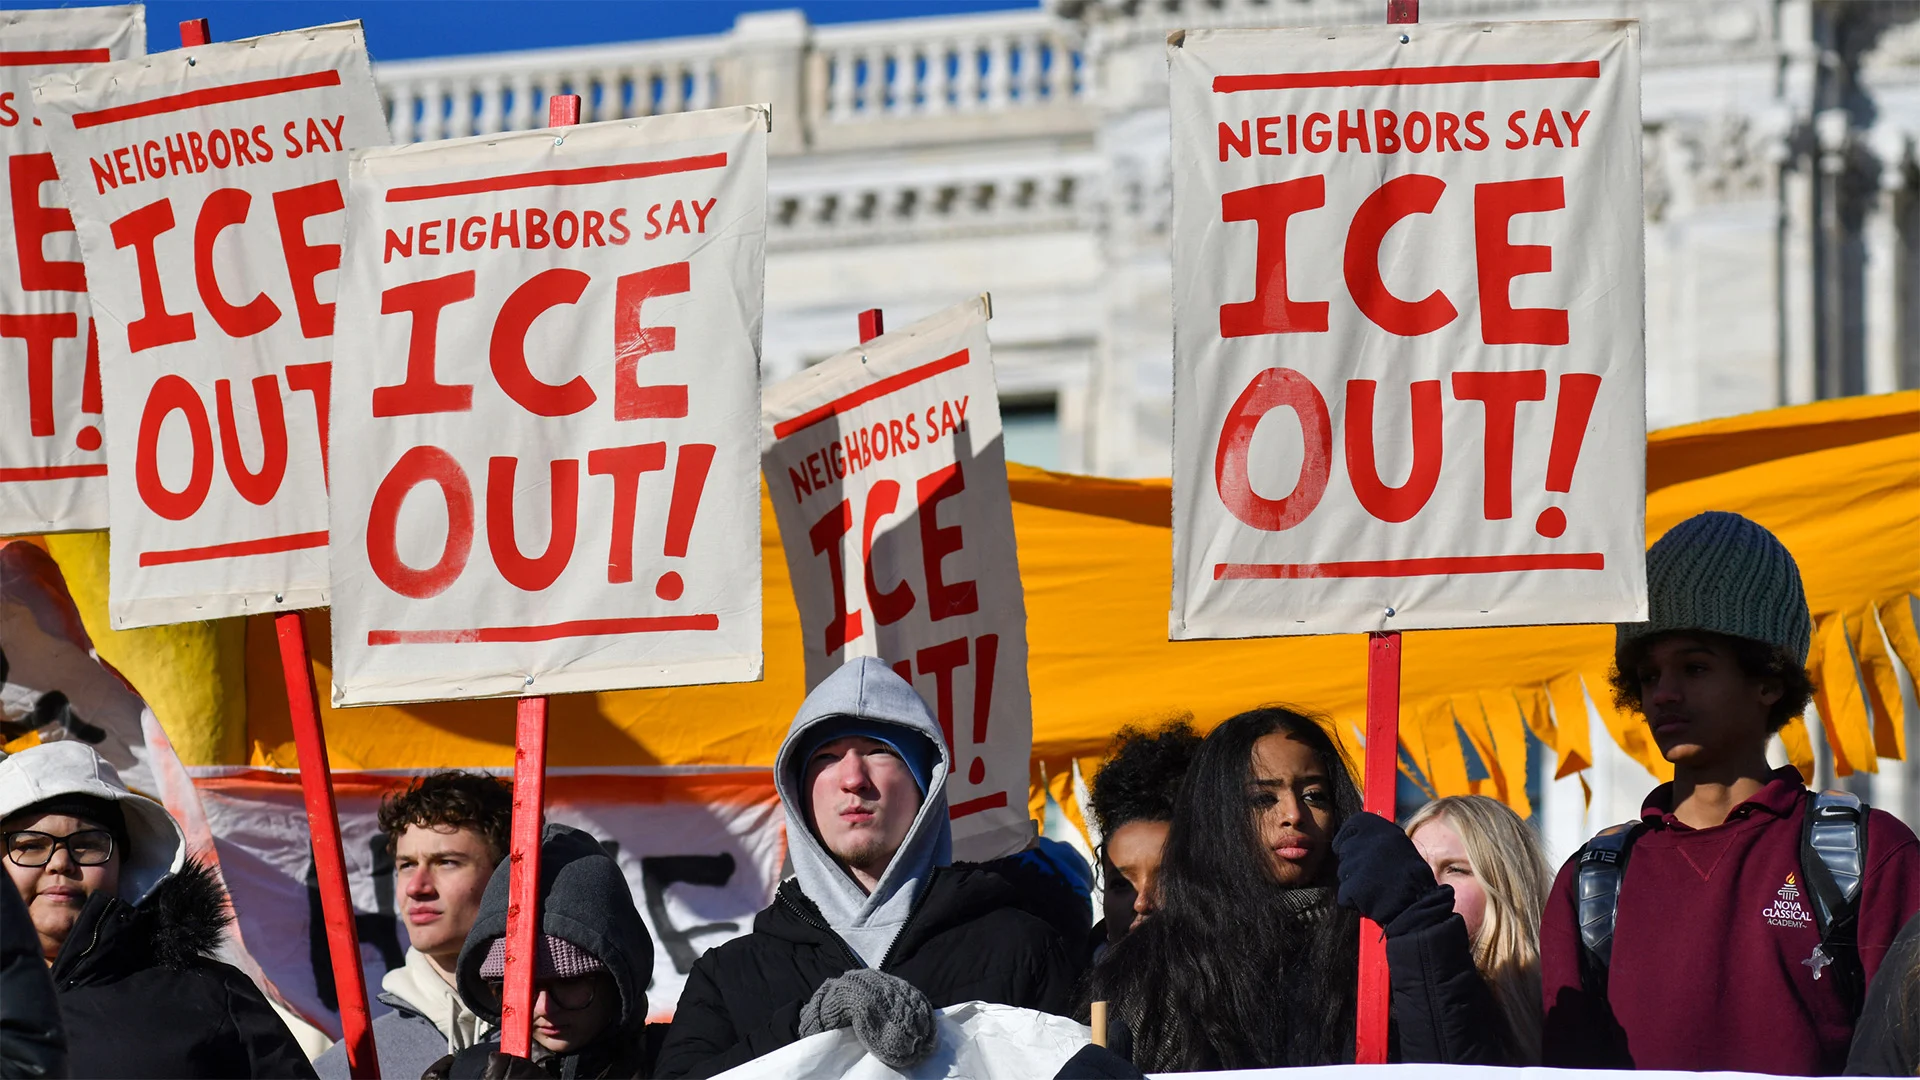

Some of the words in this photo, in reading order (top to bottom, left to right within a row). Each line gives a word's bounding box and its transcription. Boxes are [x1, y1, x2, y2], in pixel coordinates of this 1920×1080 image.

[90, 125, 273, 195] NEIGHBORS
[284, 116, 344, 158] SAY
[1219, 109, 1489, 162] NEIGHBORS
[1506, 109, 1590, 150] SAY
[110, 179, 344, 353] ICE
[384, 209, 629, 263] NEIGHBORS
[645, 198, 716, 239] SAY
[1220, 174, 1569, 345] ICE
[373, 262, 690, 421] ICE
[136, 361, 332, 520] OUT
[790, 415, 919, 503] NEIGHBORS
[927, 396, 968, 443] SAY
[1215, 368, 1602, 538] OUT!
[367, 442, 716, 601] OUT!
[810, 462, 978, 655] ICE
[1762, 908, 1812, 921] CLASSICAL
[1774, 900, 1802, 911] NOVA
